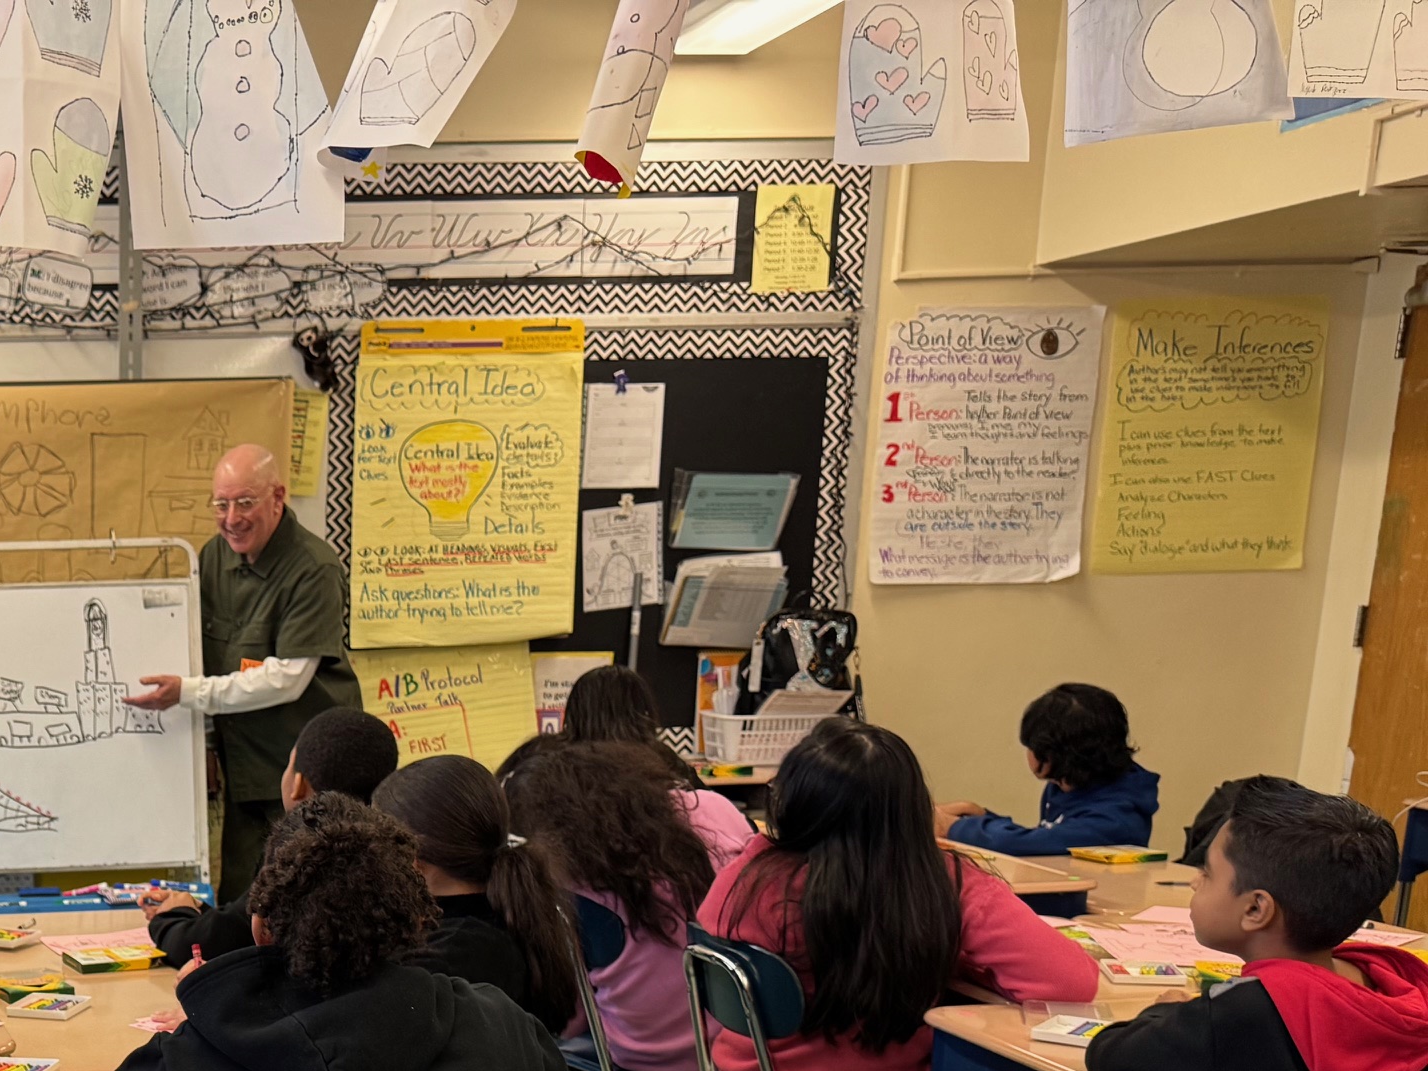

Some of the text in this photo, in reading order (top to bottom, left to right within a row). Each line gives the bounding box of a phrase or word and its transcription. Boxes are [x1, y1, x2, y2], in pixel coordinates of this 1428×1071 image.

[909, 320, 1021, 349] Point of View
[1136, 324, 1314, 357] Make Inferences
[888, 346, 1022, 370] Perspective: a way
[372, 367, 536, 398] Central Idea
[884, 367, 1055, 387] of thinking about something
[884, 391, 903, 422] 1
[997, 388, 1017, 403] the
[1021, 390, 1052, 409] story
[1059, 385, 1089, 401] from
[909, 400, 963, 421] Person:
[506, 433, 553, 450] Evaluate
[1131, 430, 1151, 441] can
[1154, 430, 1172, 439] use
[1176, 427, 1206, 439] clues
[1211, 422, 1233, 437] from
[1237, 423, 1254, 436] the
[404, 445, 459, 461] Central
[884, 443, 900, 467] 2
[915, 447, 962, 467] Person:
[961, 446, 980, 466] The
[1004, 469, 1014, 479] to
[1196, 470, 1239, 484] FAST
[1241, 469, 1275, 482] Clues
[882, 484, 894, 503] 3
[1046, 487, 1065, 501] not
[484, 515, 545, 535] Details
[979, 520, 997, 530] the
[1032, 502, 1064, 529] They
[1117, 506, 1166, 525] Feeling
[1116, 523, 1162, 537] Actions
[972, 549, 990, 564] the
[360, 582, 388, 602] Ask
[463, 579, 496, 599] What
[517, 579, 539, 597] the
[358, 600, 524, 624] author trying to tell me?
[421, 663, 483, 692] Protocol
[387, 692, 461, 714] Partner Talk
[410, 735, 446, 754] FIRST
